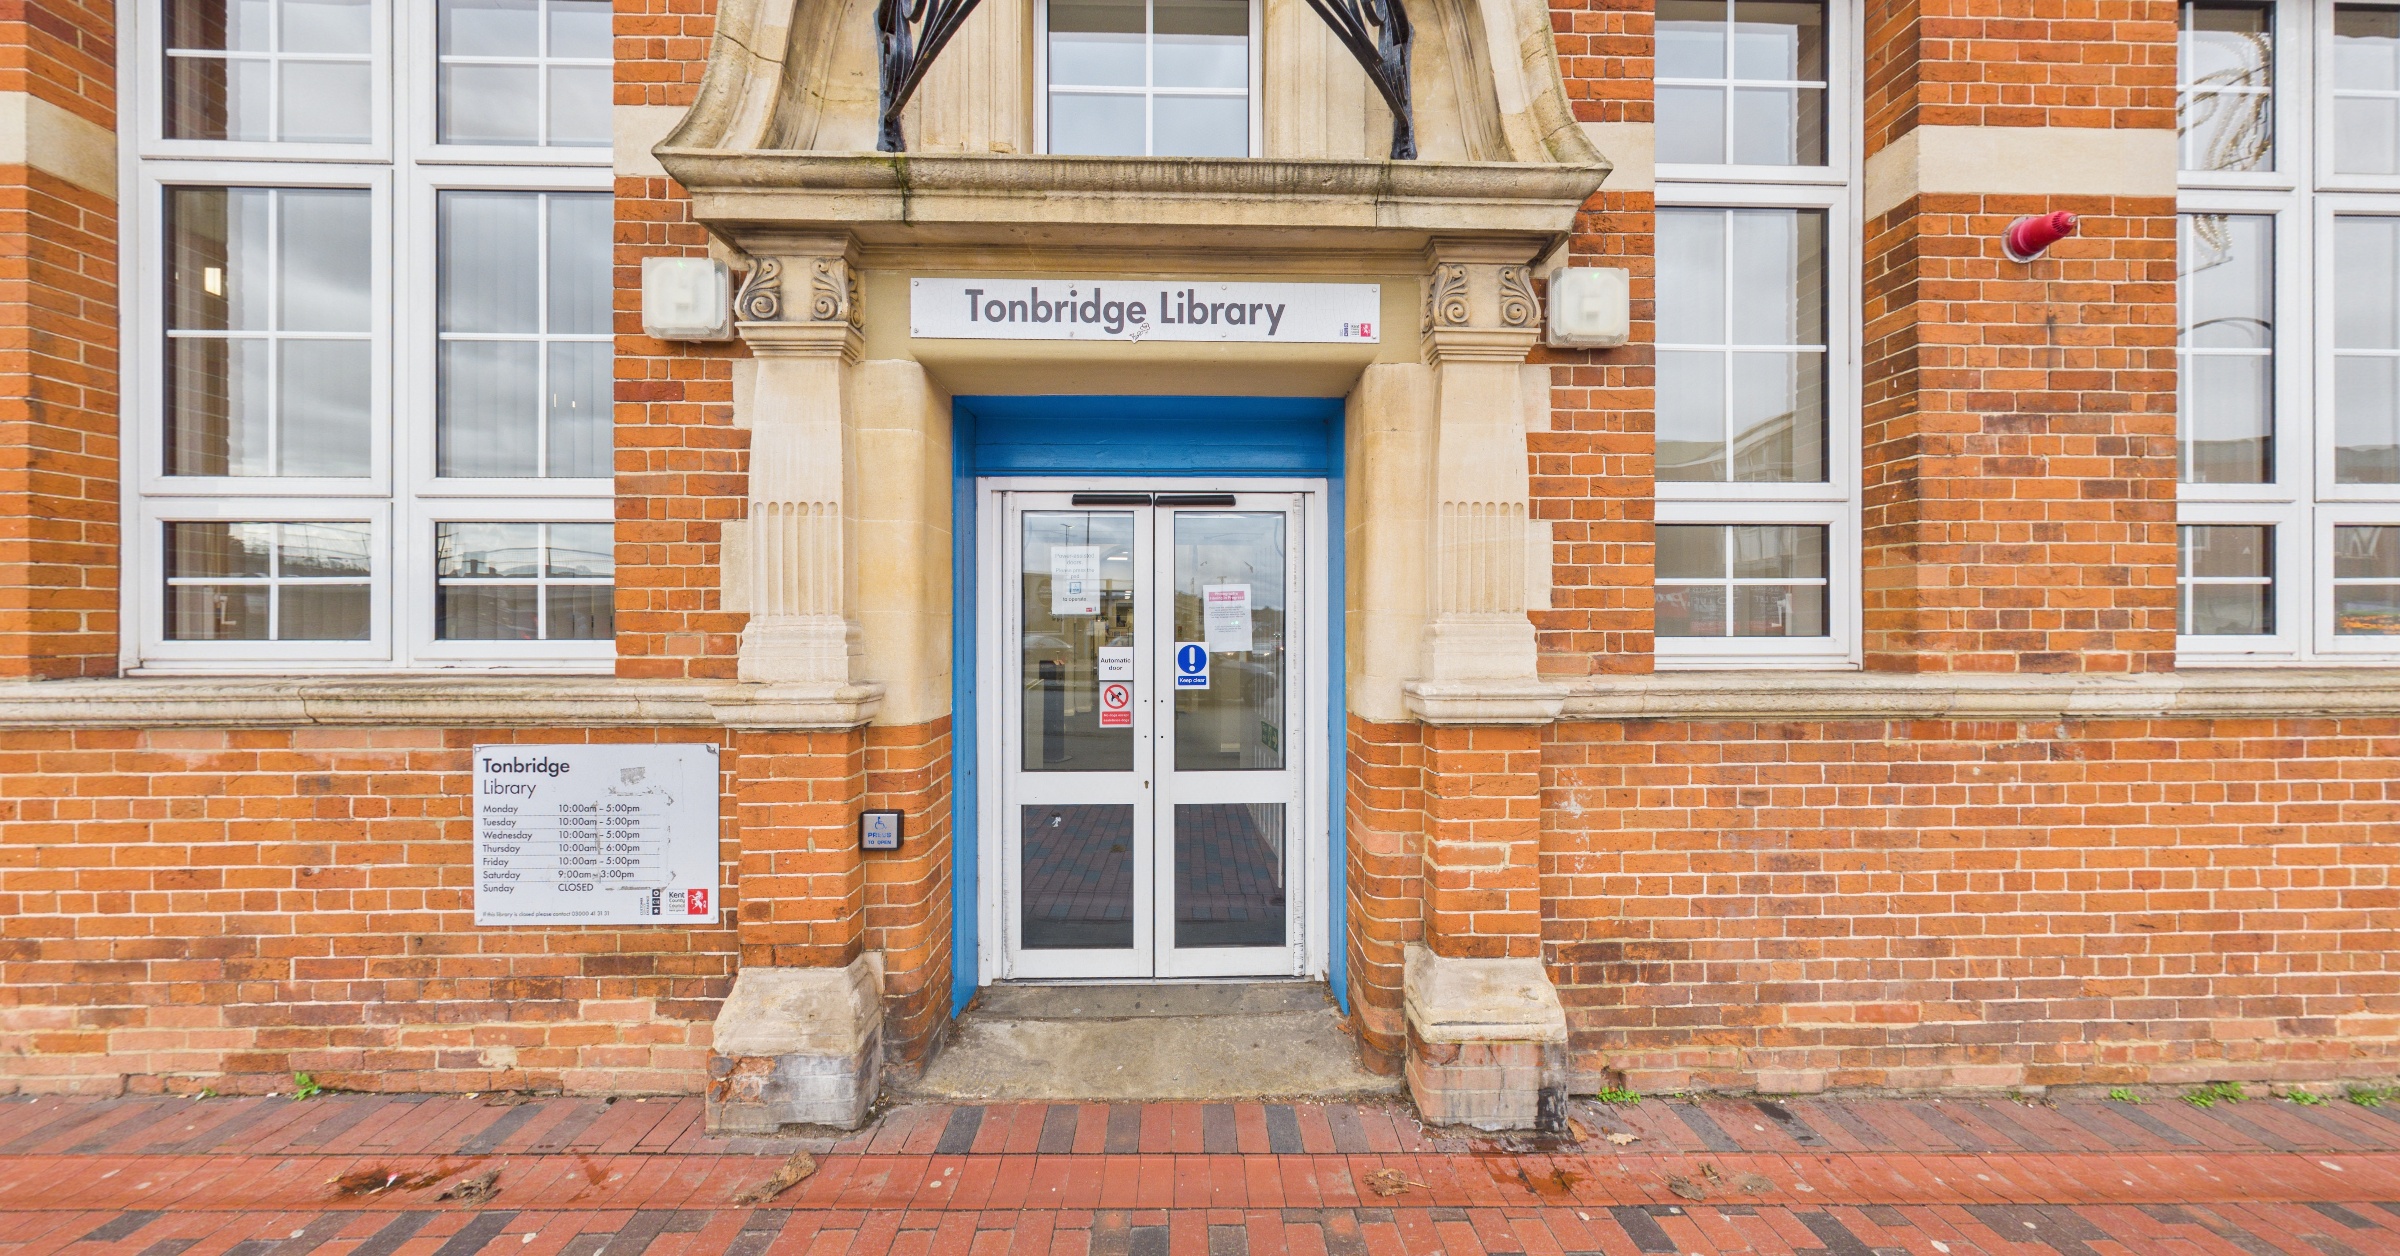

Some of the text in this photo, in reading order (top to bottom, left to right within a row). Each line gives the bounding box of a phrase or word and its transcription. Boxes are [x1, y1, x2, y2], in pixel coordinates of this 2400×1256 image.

[965, 287, 1286, 336] Tonbridge Library
[483, 757, 570, 777] Tonbridge
[483, 778, 537, 799] Library
[483, 804, 518, 814] Monday
[558, 804, 597, 813] 10:00am
[606, 804, 640, 815] 5:00pm
[483, 817, 517, 828] Tuesday
[558, 817, 597, 826] 10:00am
[606, 817, 640, 828] 5:00pm
[483, 830, 533, 840] Wednesday
[558, 830, 597, 839] 10:00am
[606, 830, 640, 841] 5:00pm
[483, 843, 520, 854] Thursday
[558, 844, 597, 853] 10:00am
[606, 844, 640, 855] 6:00pm
[483, 856, 509, 867] Friday
[558, 857, 597, 866] 10:00am
[606, 857, 640, 868] 5:00pm
[483, 870, 520, 880] Saturday
[558, 870, 591, 879] 9:00am
[600, 870, 634, 881] 3:00pm
[483, 883, 594, 894] Sunday CLOSED
